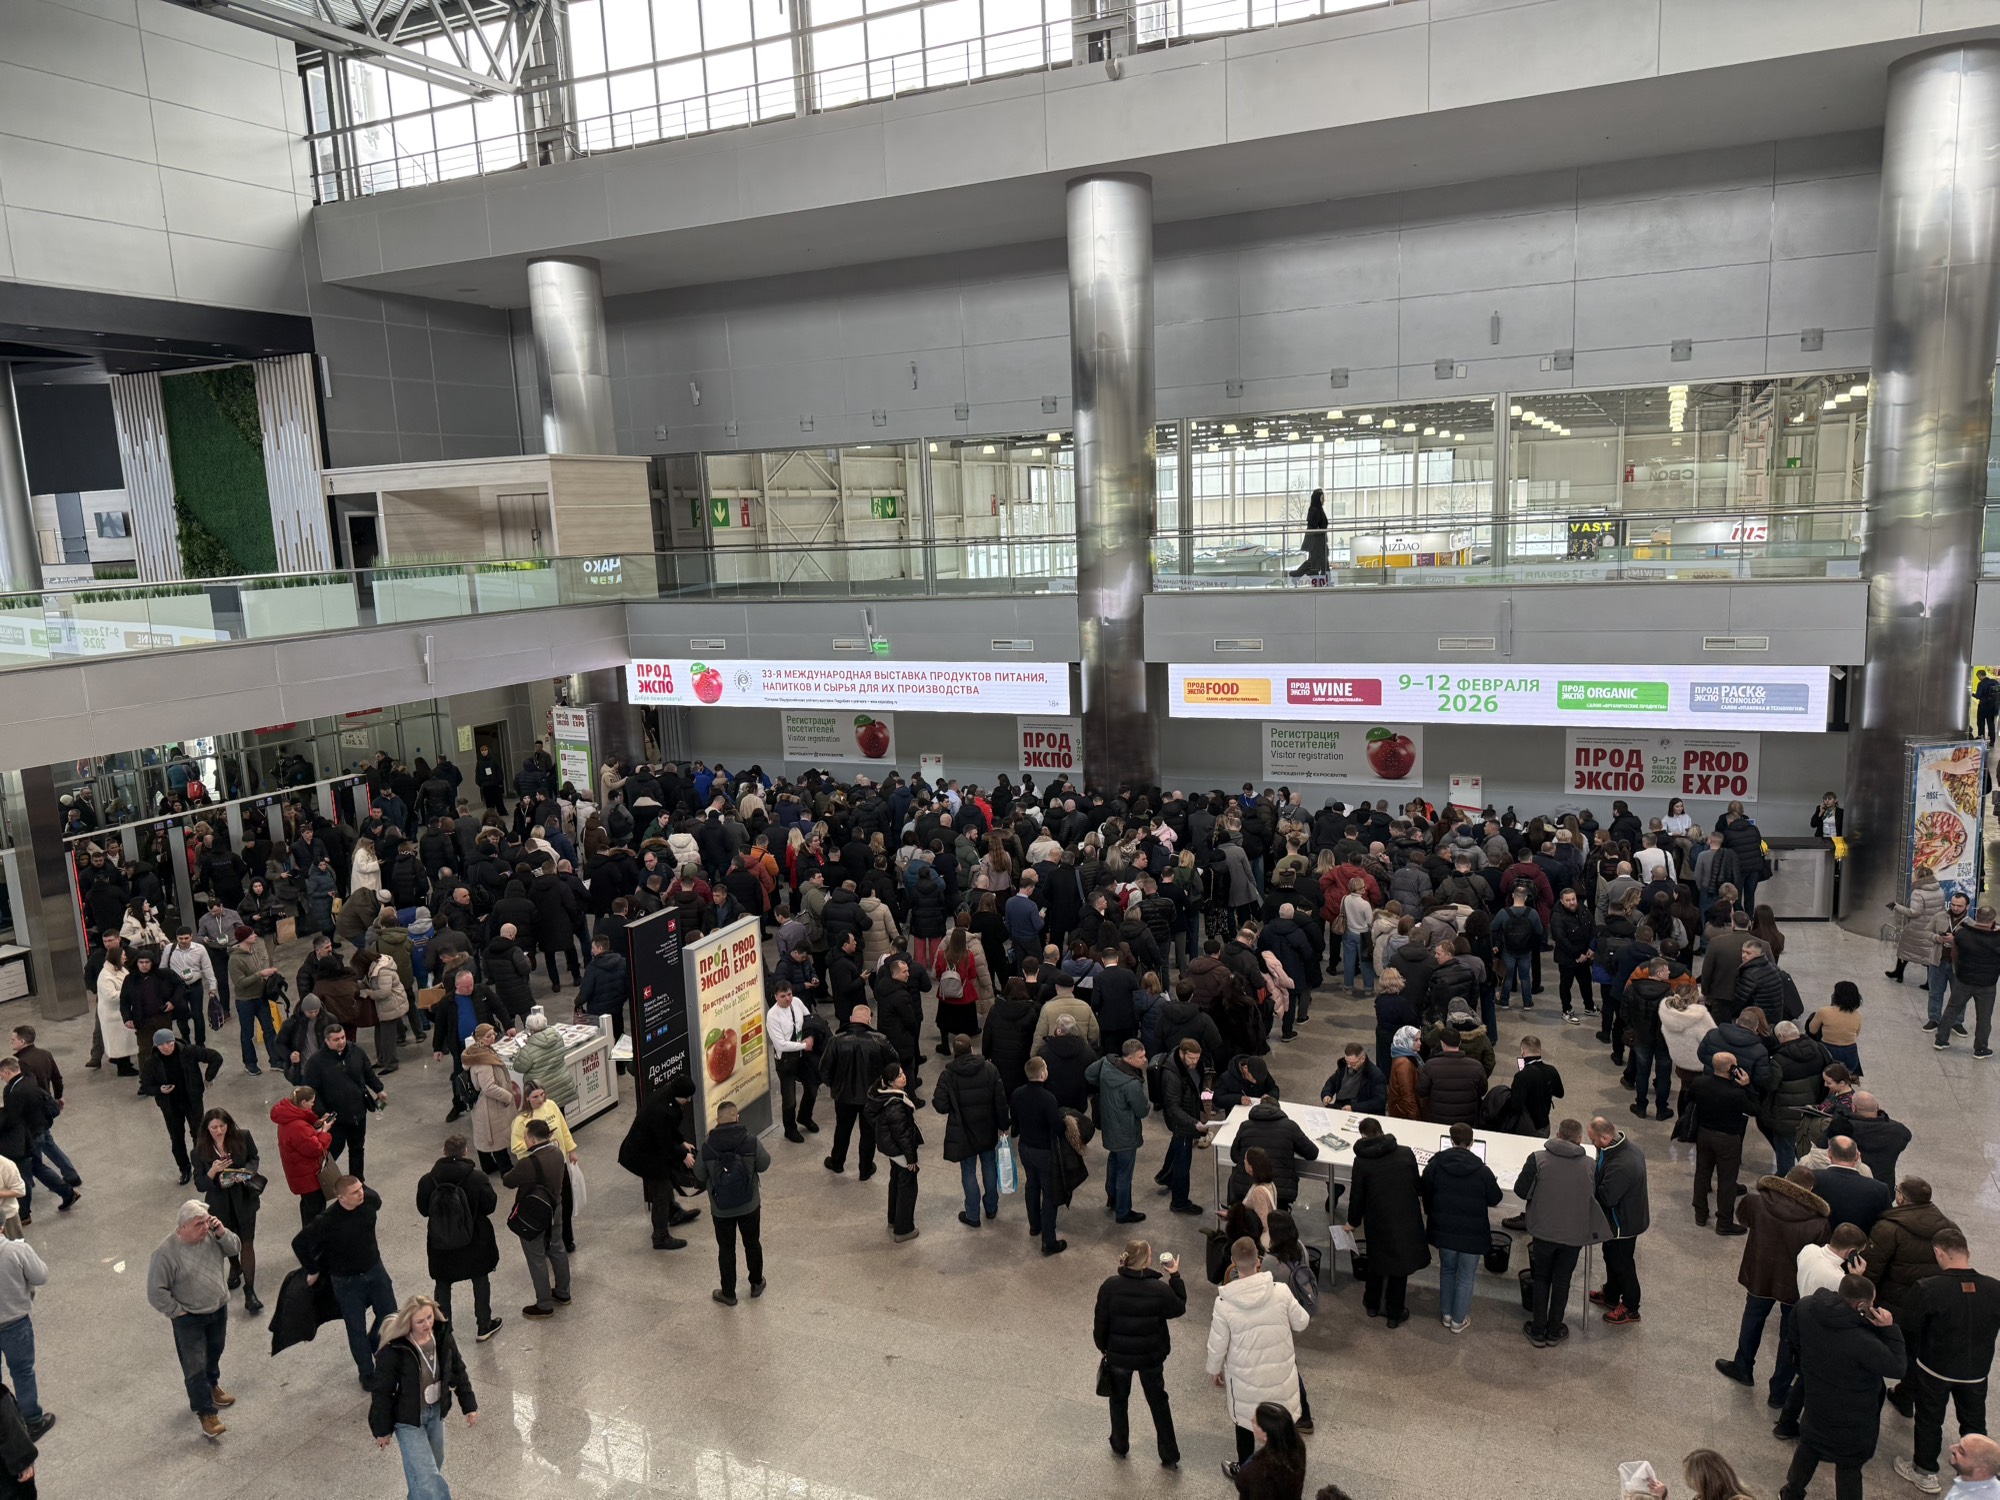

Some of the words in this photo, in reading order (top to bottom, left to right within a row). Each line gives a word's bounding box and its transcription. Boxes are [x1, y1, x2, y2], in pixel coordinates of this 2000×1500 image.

[1570, 522, 1612, 532] VAST
[1379, 542, 1420, 552] MIZDAO
[637, 664, 672, 680] ПРОД
[762, 670, 781, 678] 33-Я
[784, 670, 872, 680] МЕЖДУНАРОДНАЯ
[874, 671, 927, 680] ВЫСТАВКА
[930, 671, 992, 682] ПРОДУКТОВ
[995, 672, 1048, 683] ПИТАНИЯ,
[638, 680, 674, 693] ЭКСПО
[762, 682, 812, 691] НАПИТКОВ
[814, 683, 820, 691] И
[823, 683, 856, 692] СЫРЬЯ
[859, 684, 879, 694] ДЛЯ
[882, 684, 895, 693] ИХ
[898, 684, 980, 696] ПРОИЗВОДСТВА
[1206, 682, 1239, 695] FOOD
[1312, 682, 1352, 696] WINE
[1457, 678, 1540, 691] ФЕВРАЛЯ
[1695, 686, 1719, 694] ПРОД
[1721, 685, 1766, 697] PACK&
[1587, 687, 1638, 699] ORGANIC
[1694, 694, 1719, 702] ЭКСПО
[1048, 700, 1059, 708] 18+
[1437, 694, 1498, 712] 2026
[786, 715, 836, 726] Регистрация
[787, 725, 834, 733] посетителей
[1270, 728, 1340, 740] Регистрация
[787, 734, 806, 742] Visitor
[807, 735, 840, 743] registration
[1023, 731, 1071, 752] ПРОД
[1271, 739, 1336, 749] посетителей
[1023, 751, 1072, 768] ЭКСПО
[1271, 750, 1296, 759] Visitor
[1298, 751, 1344, 761] registration
[1576, 748, 1643, 772] ПРОД
[1683, 750, 1749, 773] PROD
[1574, 770, 1644, 792] ЭКСПО
[1651, 775, 1676, 784] 2026
[1682, 774, 1748, 796] EXPO
[732, 934, 755, 958] PROD
[700, 948, 728, 974] ПРОД
[733, 950, 756, 974] EXPO
[701, 965, 730, 992] ЭКСПО
[702, 1002, 710, 1014] До
[710, 991, 731, 1005] встречи
[735, 981, 746, 994] 2027
[715, 1005, 723, 1017] See
[723, 1002, 732, 1012] You
[732, 999, 737, 1007] at
[582, 1052, 599, 1066] ПРОД
[648, 1065, 660, 1080] До
[661, 1050, 685, 1068] новых
[582, 1060, 600, 1075] ЭКСПО
[654, 1060, 683, 1085] встреч!
